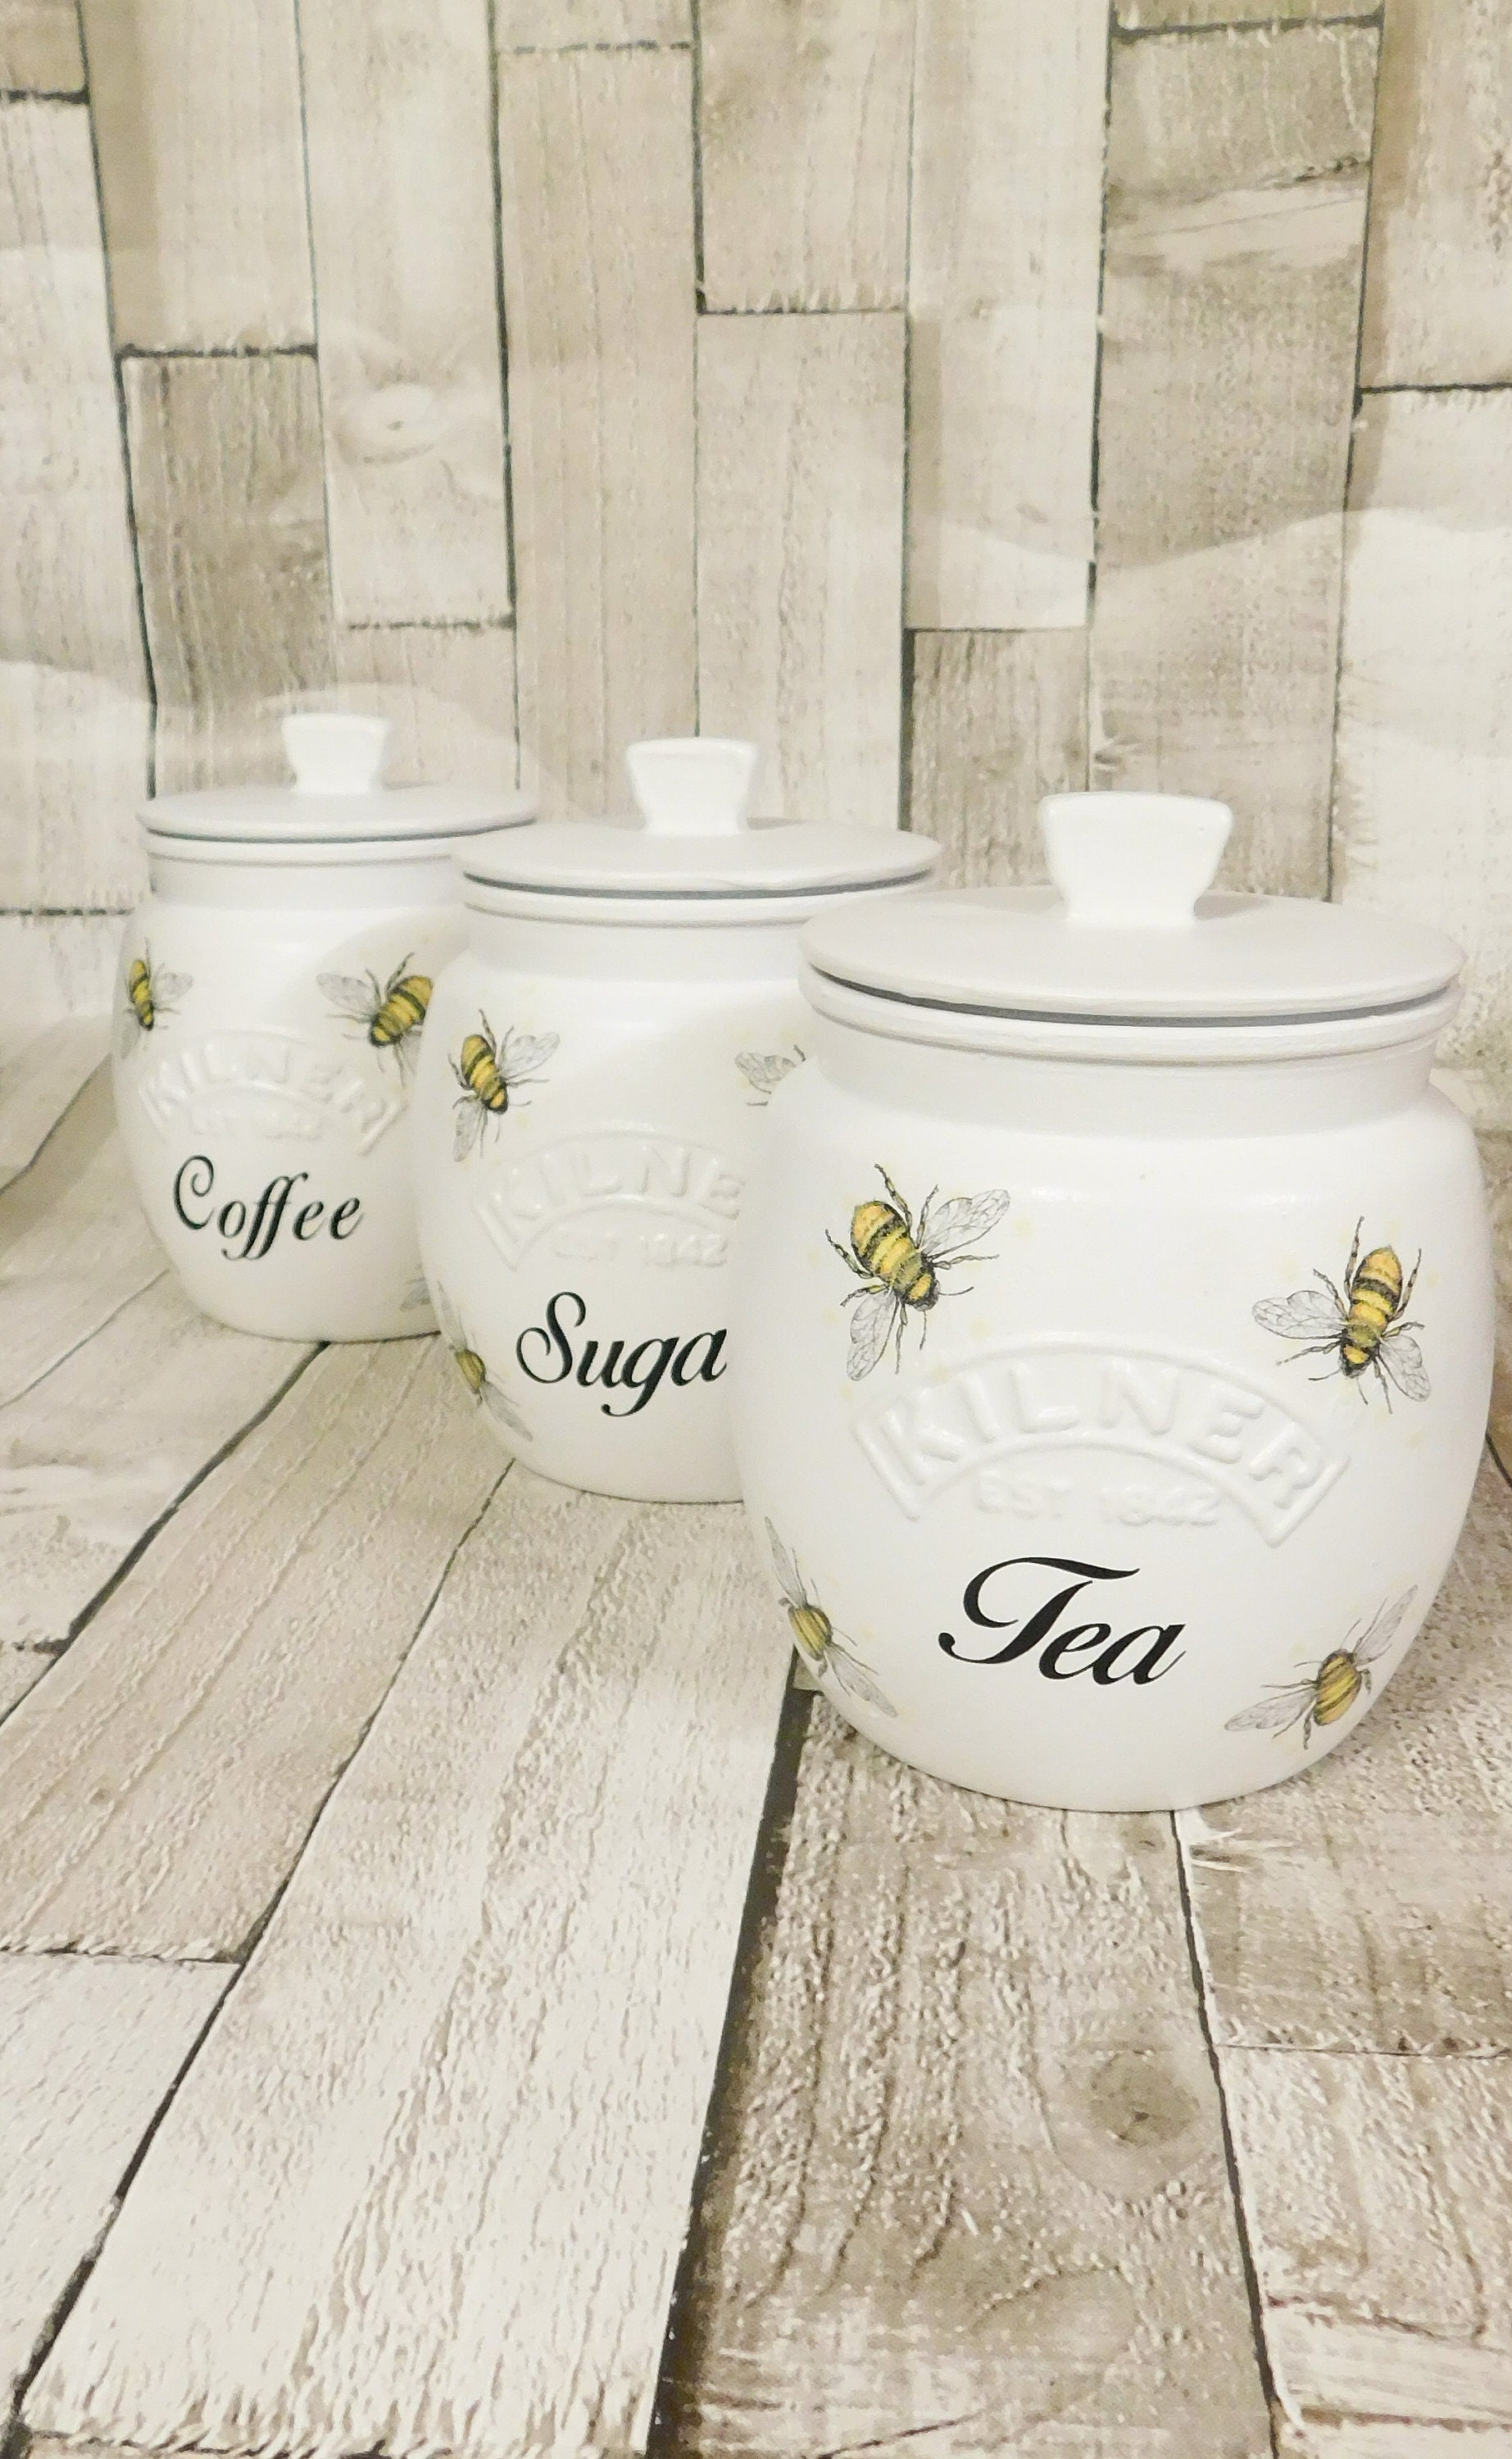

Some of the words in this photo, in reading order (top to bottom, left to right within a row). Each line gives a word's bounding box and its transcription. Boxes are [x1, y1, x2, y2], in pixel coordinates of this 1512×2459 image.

[174, 1155, 362, 1260] Coffee
[489, 1143, 746, 1243] KILNE
[515, 1291, 728, 1417] Suga
[879, 1357, 1326, 1510] KILNER
[974, 1468, 1073, 1520] EST
[938, 1557, 1187, 1685] Tea
